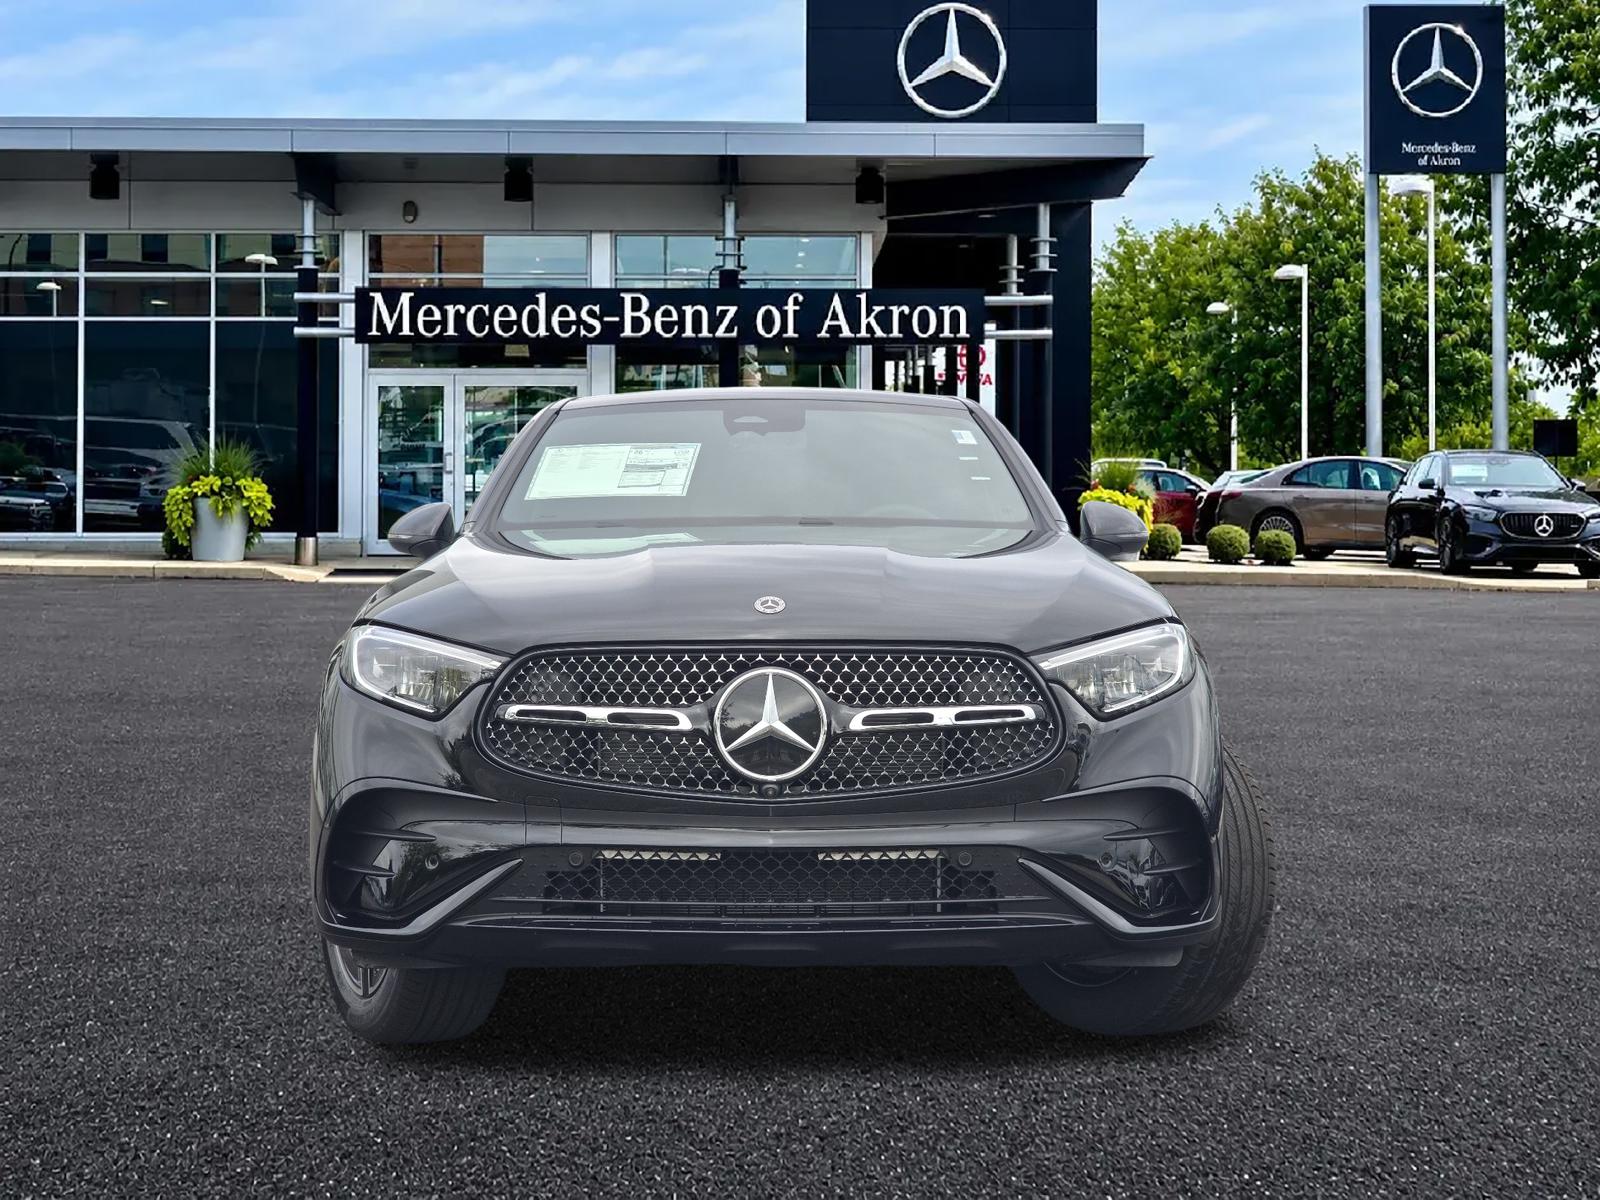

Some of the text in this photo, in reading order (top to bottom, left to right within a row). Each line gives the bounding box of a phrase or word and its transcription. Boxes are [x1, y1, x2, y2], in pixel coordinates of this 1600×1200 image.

[1401, 142, 1476, 153] Mercedes-Benz
[1418, 154, 1461, 165] of Akron
[367, 291, 970, 338] Mercedes-Benz of Akron
